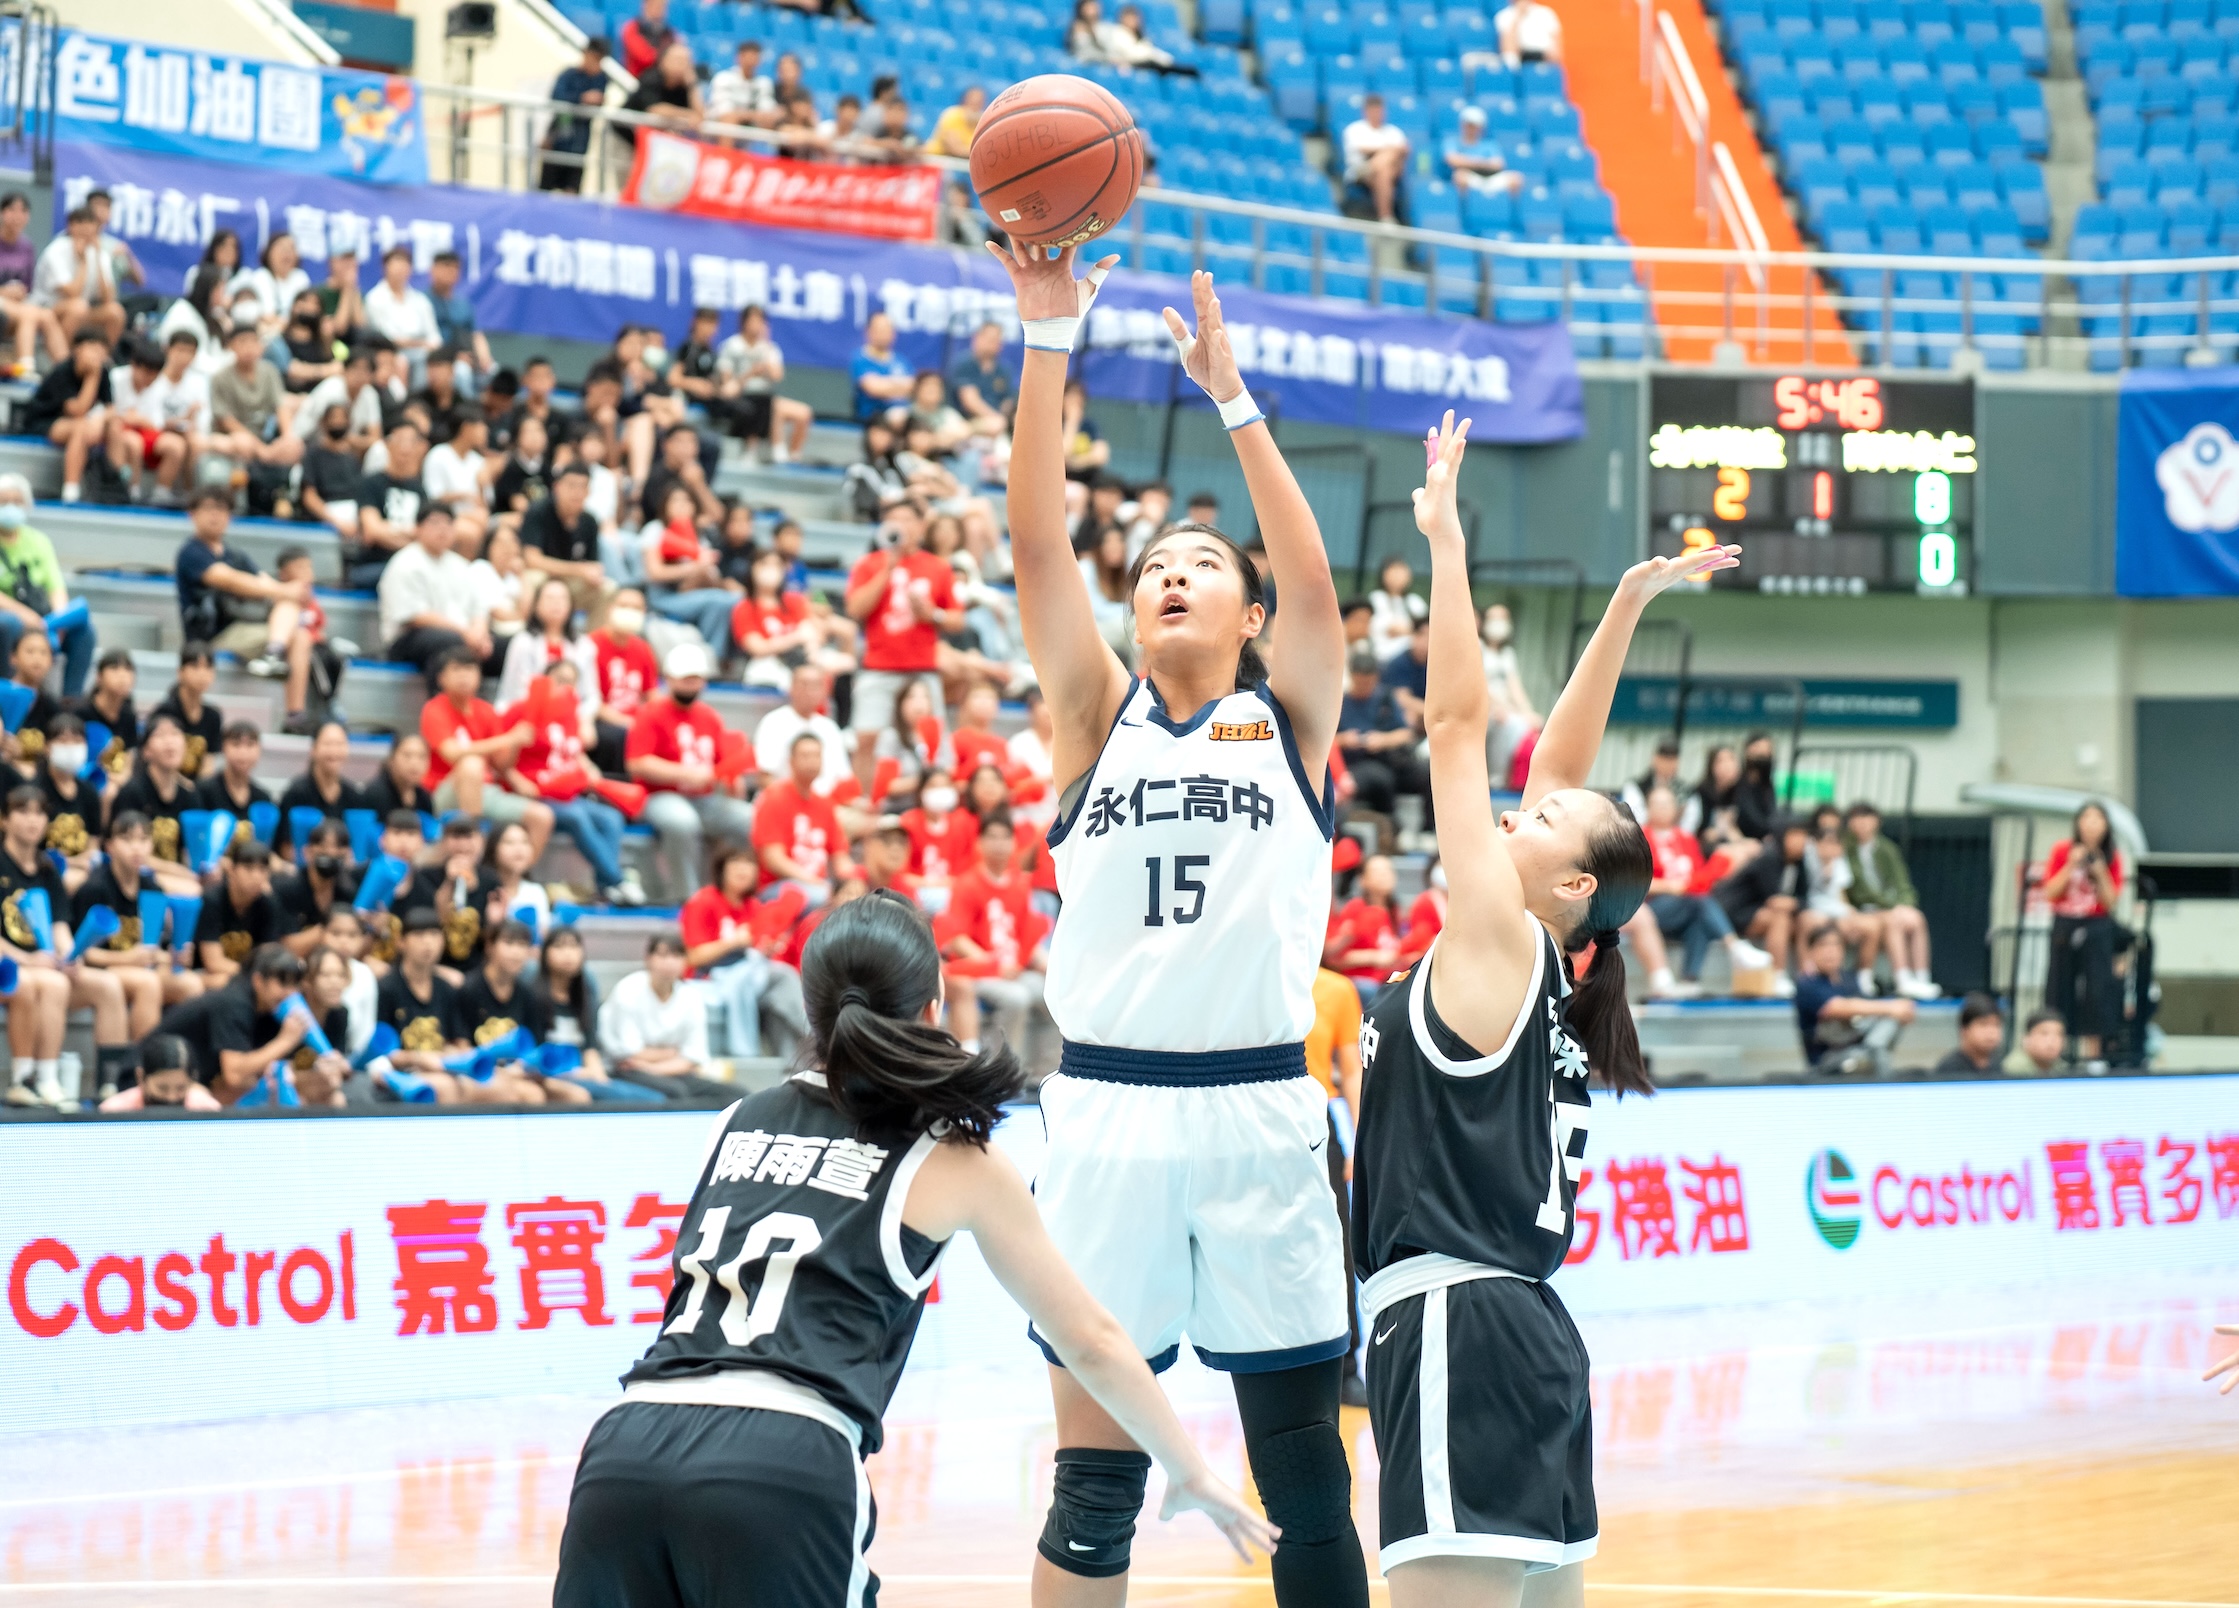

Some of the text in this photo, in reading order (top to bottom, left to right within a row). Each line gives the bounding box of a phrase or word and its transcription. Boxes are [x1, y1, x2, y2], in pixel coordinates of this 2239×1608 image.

[1774, 376, 1884, 431] 5:46
[1714, 467, 1750, 521] 2
[1814, 471, 1833, 521] 1
[1919, 532, 1957, 587] 0
[1085, 774, 1274, 838] 永仁高中
[1144, 855, 1210, 927] 15
[708, 1129, 889, 1201] 陳雨萱
[1872, 1158, 2035, 1229] Castrol
[8, 1230, 357, 1338] Castrol
[663, 1205, 823, 1347] 10
